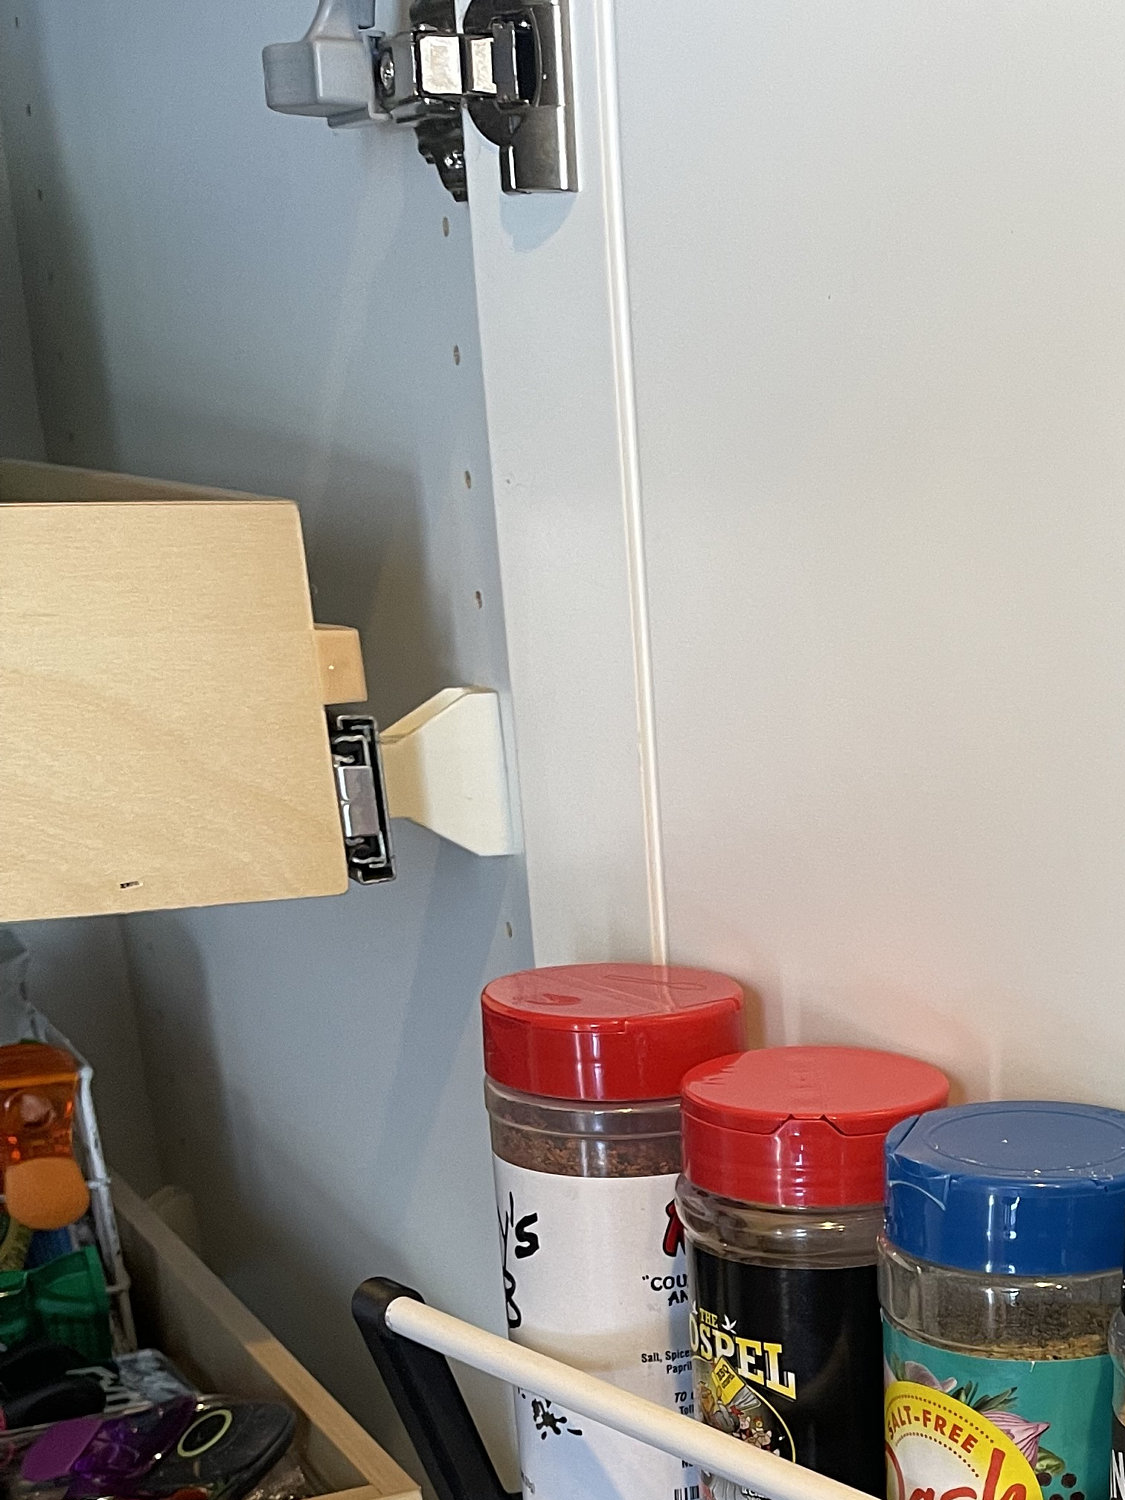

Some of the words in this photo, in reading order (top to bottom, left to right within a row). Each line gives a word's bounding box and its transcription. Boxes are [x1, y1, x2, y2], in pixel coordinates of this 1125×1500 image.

[699, 1307, 719, 1329] THE
[665, 1348, 690, 1361] Spice
[689, 1312, 797, 1401] OSPEL
[887, 1405, 979, 1454] SALT-FREE
